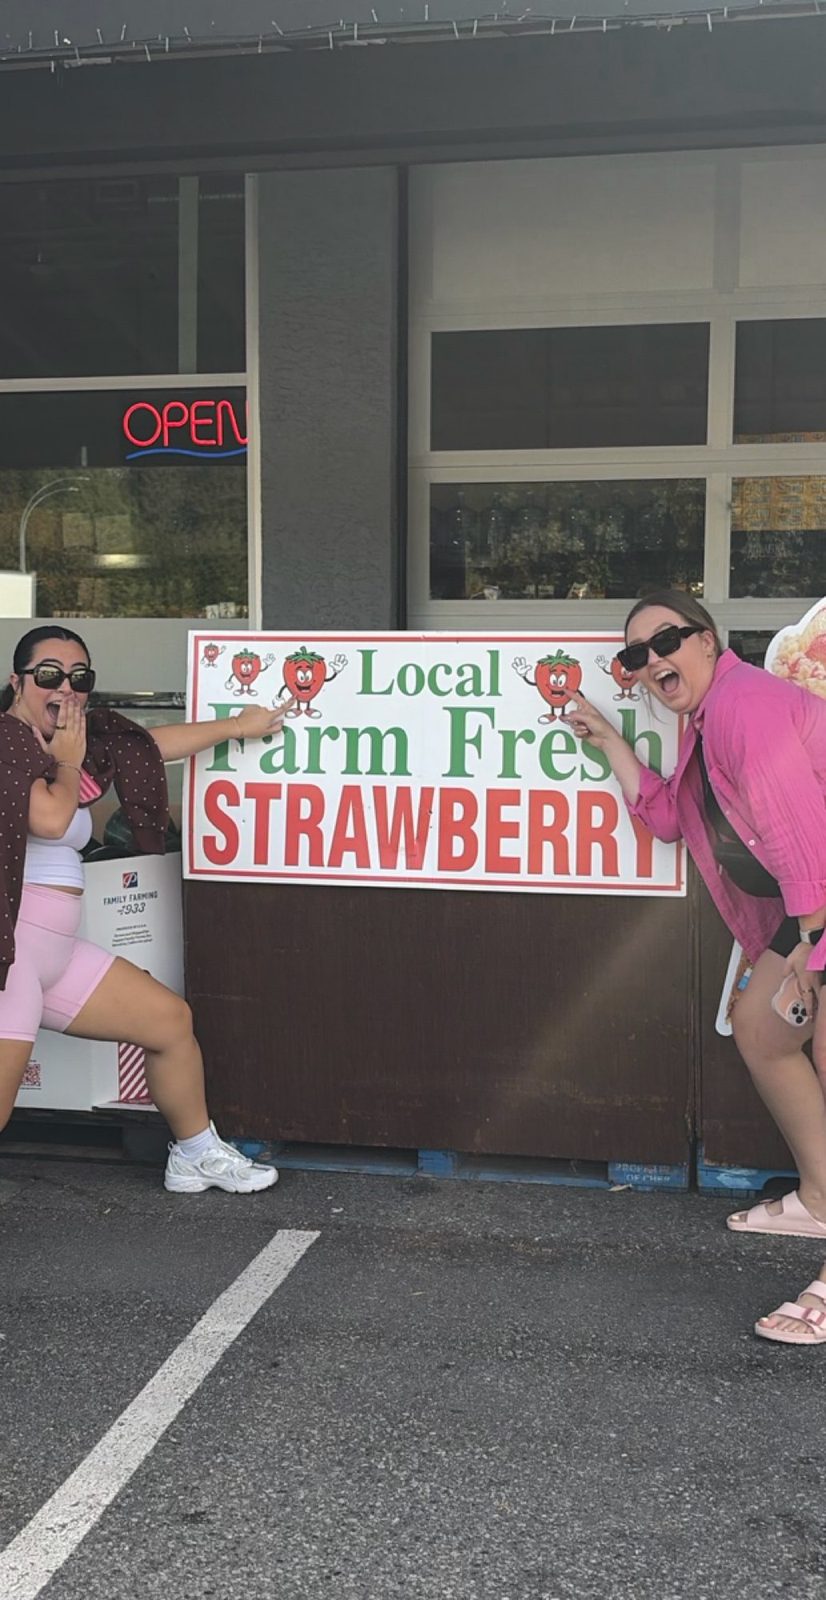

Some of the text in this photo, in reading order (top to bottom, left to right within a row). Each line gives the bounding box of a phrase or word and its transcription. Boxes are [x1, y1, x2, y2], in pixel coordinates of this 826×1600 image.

[123, 400, 248, 446] OPEN
[356, 649, 502, 697] Local
[205, 703, 663, 782] Farm Fresh
[103, 891, 158, 905] FAMILY FARMING
